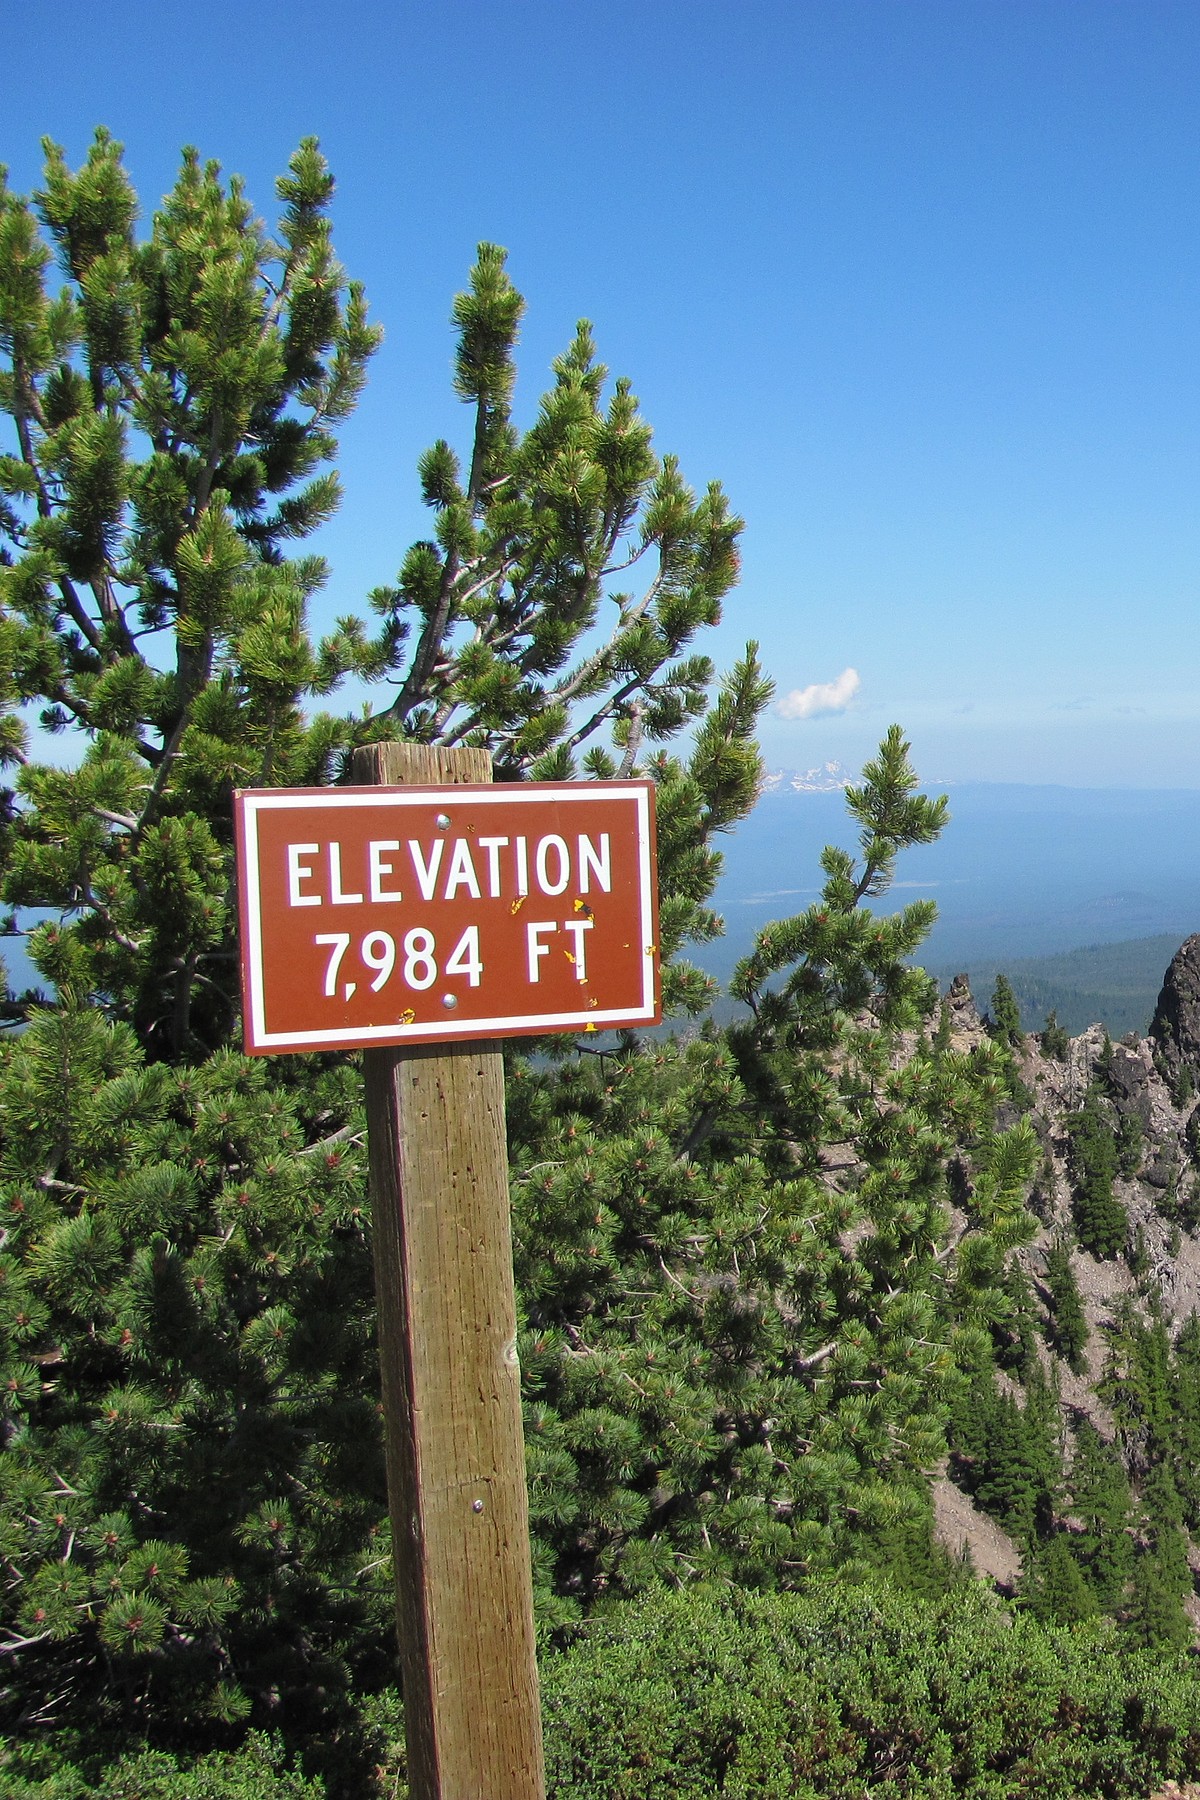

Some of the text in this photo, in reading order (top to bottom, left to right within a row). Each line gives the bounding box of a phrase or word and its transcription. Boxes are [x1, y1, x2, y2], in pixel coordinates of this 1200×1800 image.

[287, 833, 612, 907] ELEVATION
[315, 920, 595, 1002] 7,984 FT
